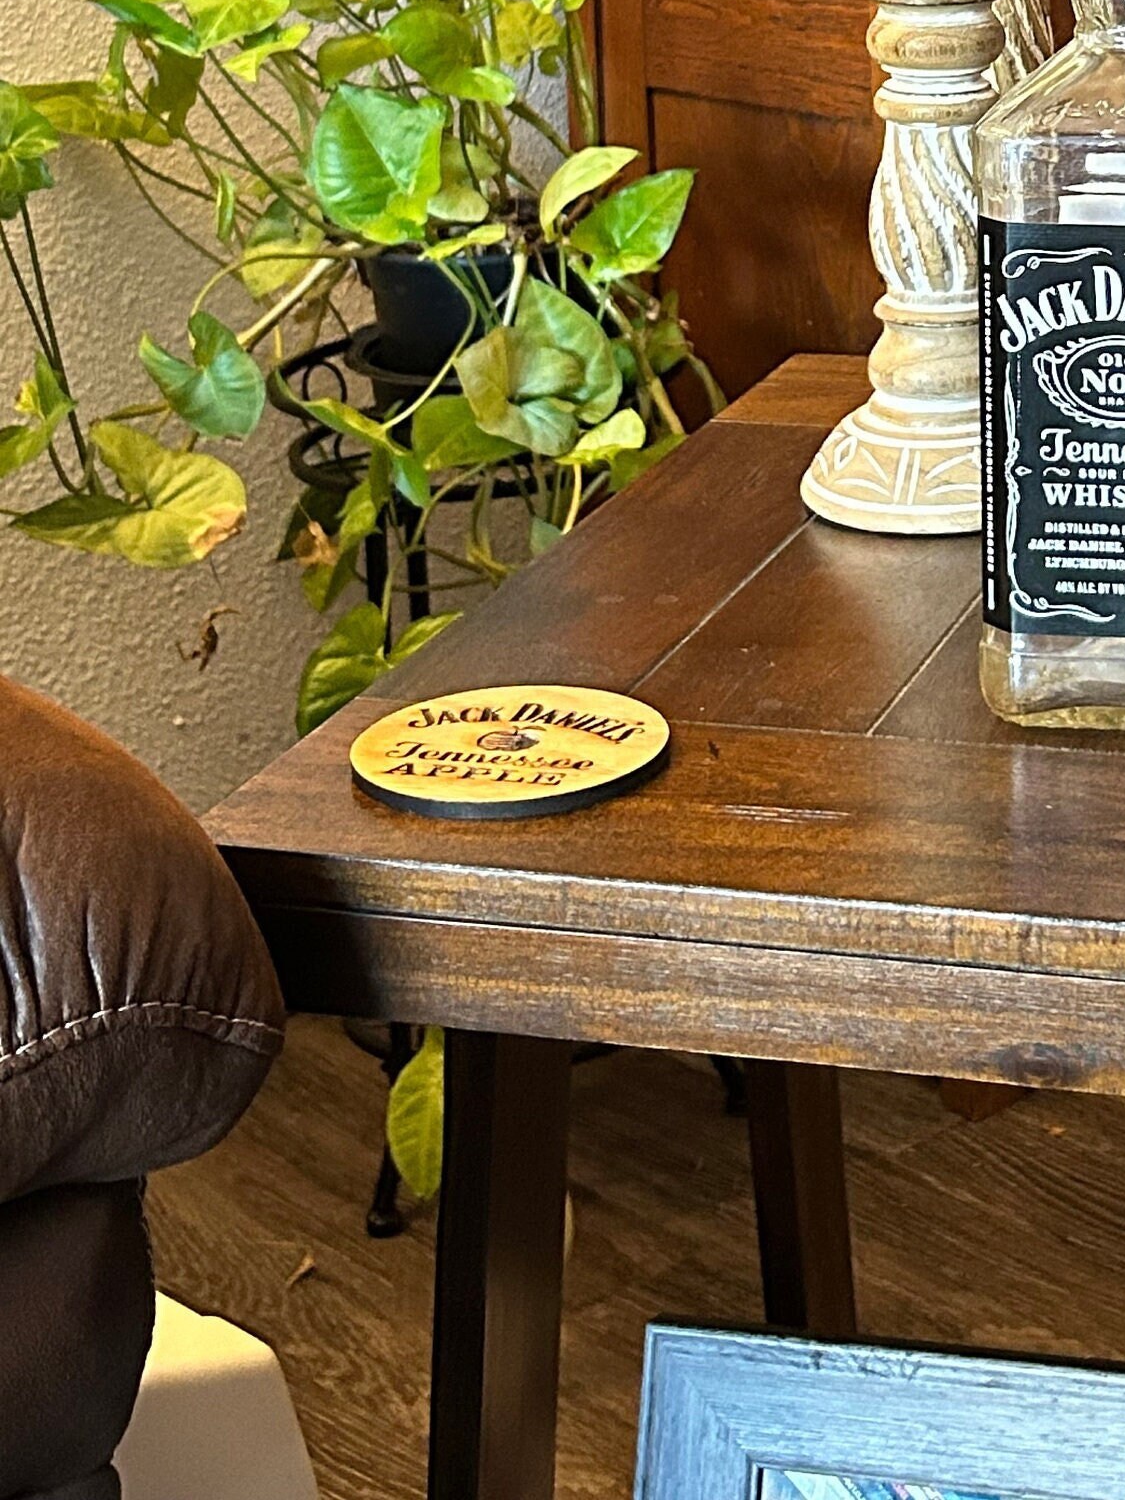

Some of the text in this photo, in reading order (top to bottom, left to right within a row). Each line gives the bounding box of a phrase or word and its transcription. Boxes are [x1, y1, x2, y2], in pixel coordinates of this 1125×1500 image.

[997, 281, 1093, 353] JACK
[1077, 468, 1117, 480] SOUR
[1044, 521, 1109, 535] DISTILLED
[1109, 524, 1121, 536] &
[1027, 538, 1066, 551] JACK
[1068, 539, 1125, 553] DANIEL
[408, 706, 505, 729] JACK
[385, 741, 595, 771] Tennessee
[383, 762, 567, 786] APPLE
